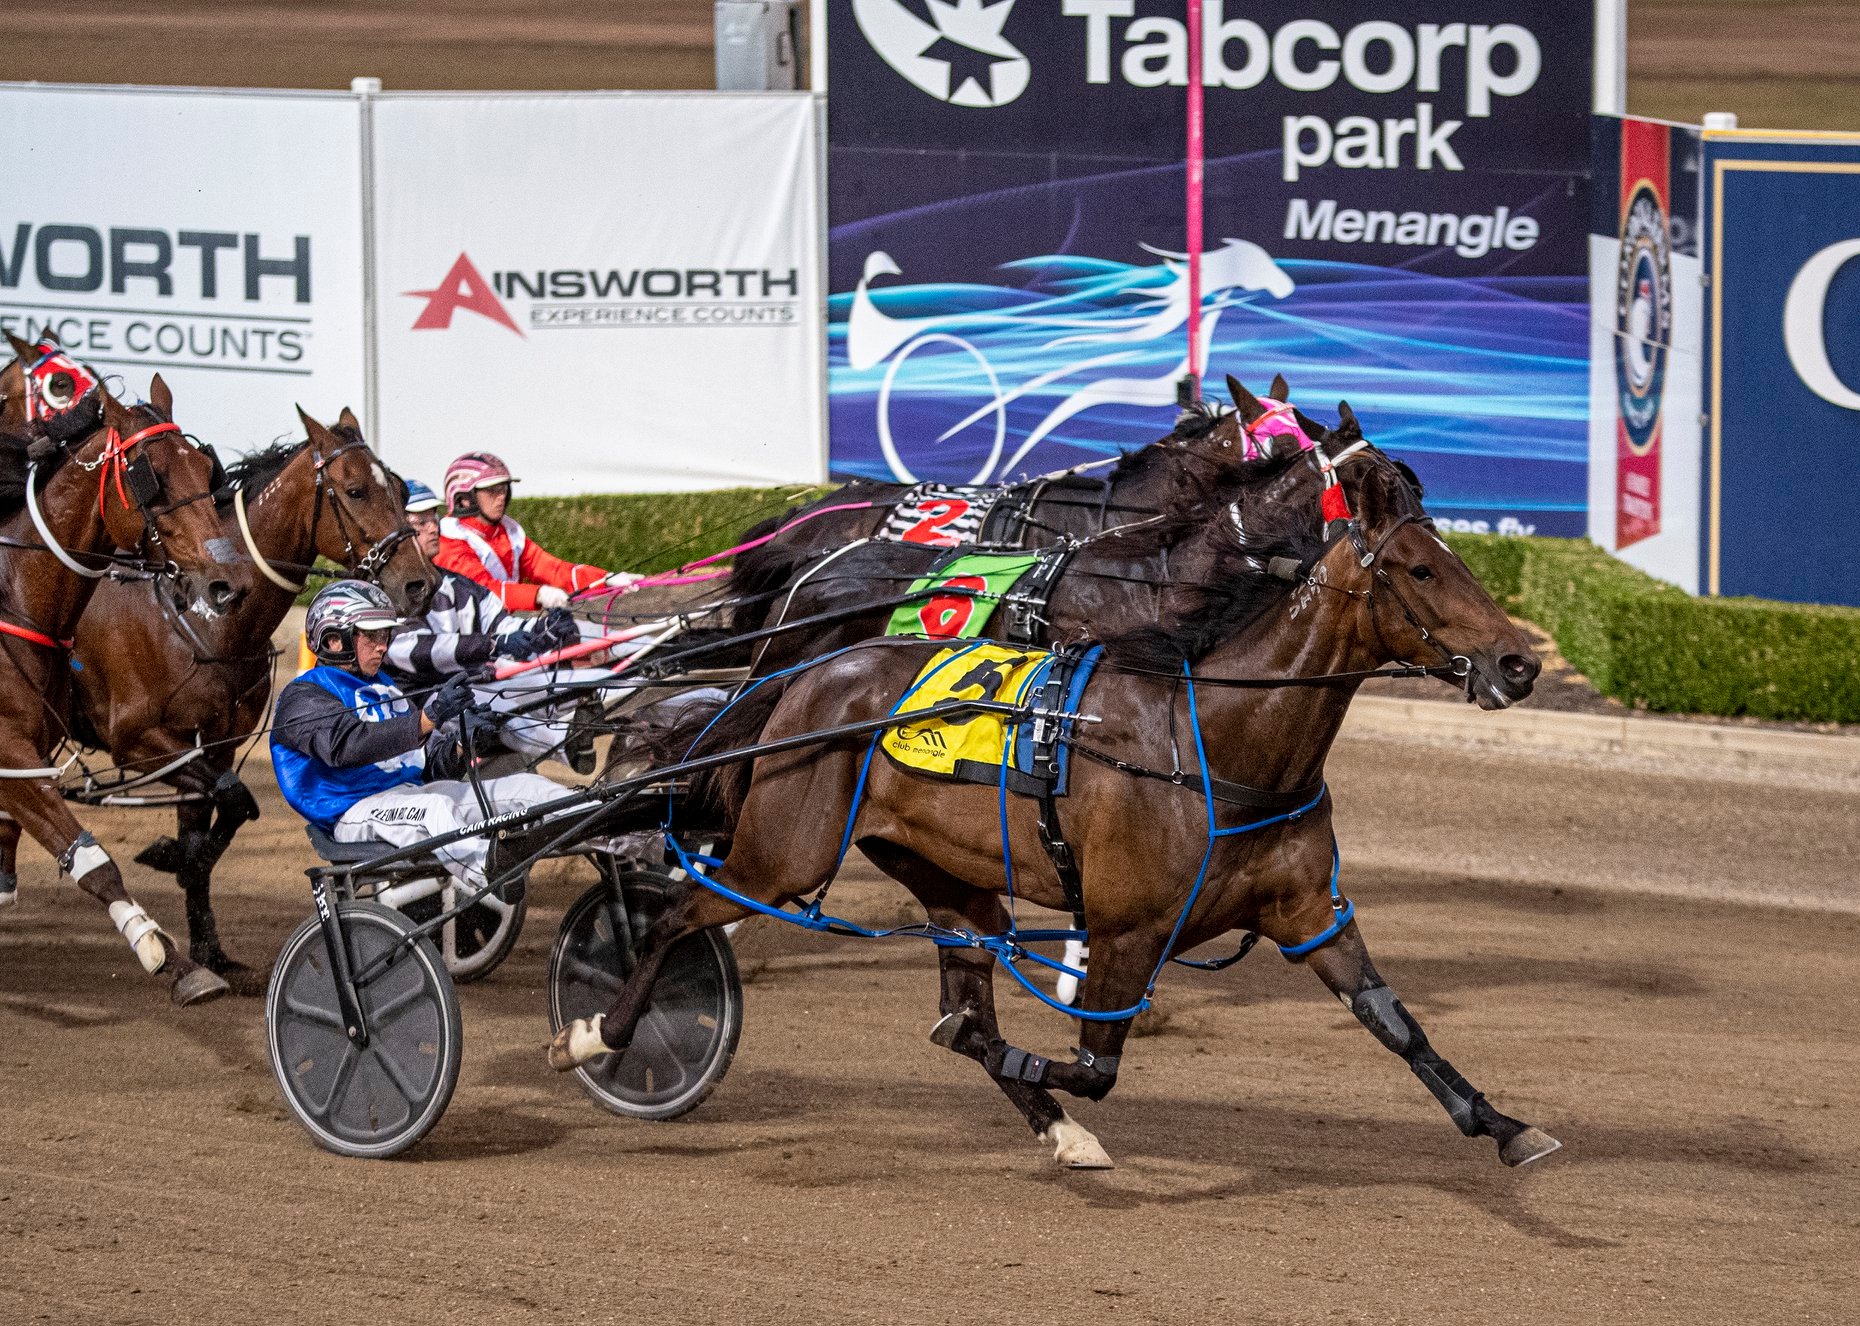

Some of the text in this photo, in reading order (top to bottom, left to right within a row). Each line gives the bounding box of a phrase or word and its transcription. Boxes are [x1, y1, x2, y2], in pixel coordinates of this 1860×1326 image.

[1062, 0, 1542, 117] Tabcorp
[1282, 102, 1465, 182] park
[1283, 199, 1540, 258] Menangle
[400, 251, 798, 340] AINSWORTH
[530, 305, 795, 324] EXPERIENCE COUNTS
[125, 321, 304, 362] COUNTS
[902, 499, 970, 547] 2
[892, 740, 911, 752] club
[459, 808, 529, 836] CAIN RACING
